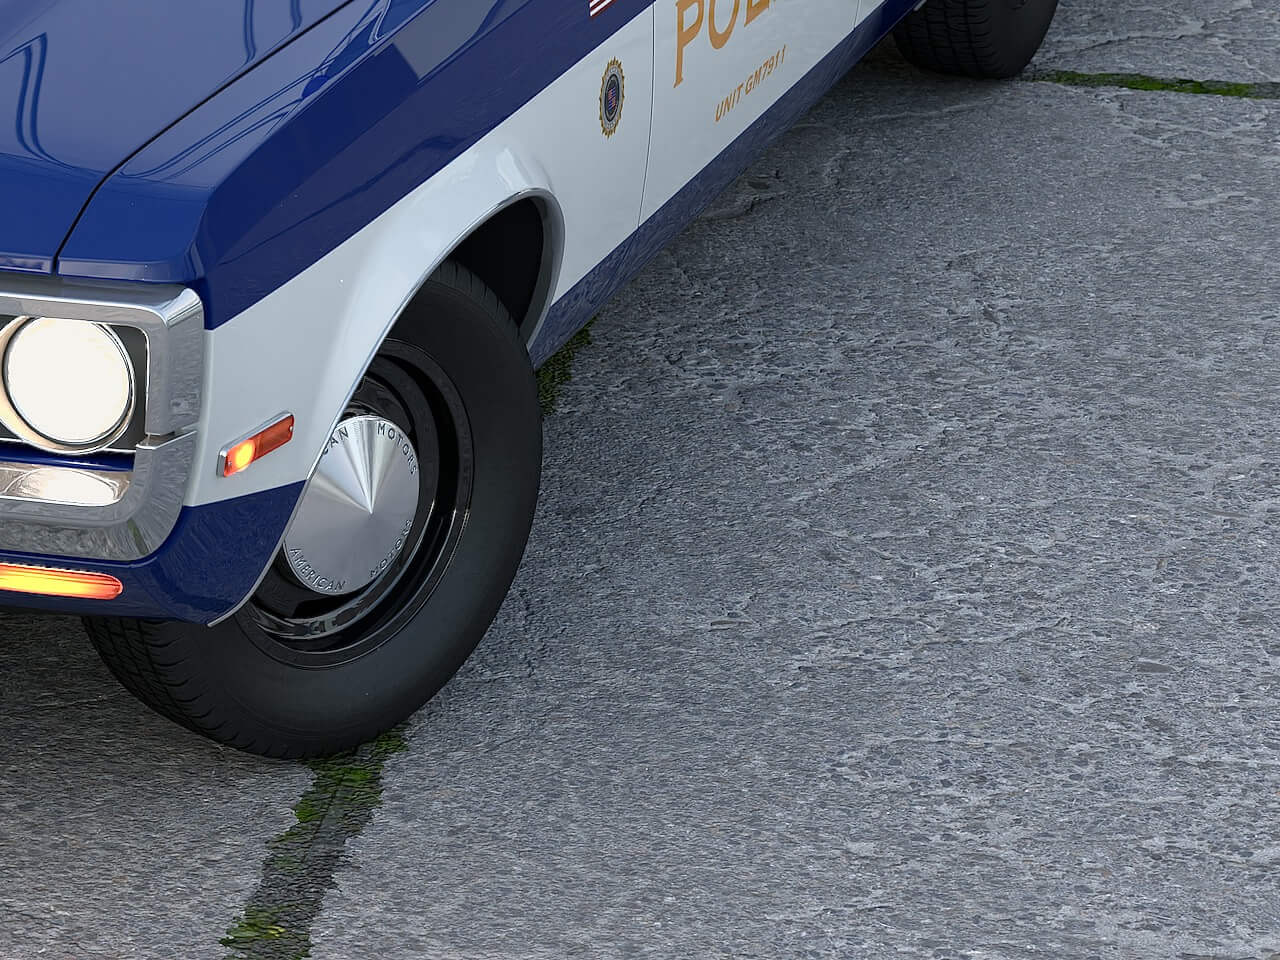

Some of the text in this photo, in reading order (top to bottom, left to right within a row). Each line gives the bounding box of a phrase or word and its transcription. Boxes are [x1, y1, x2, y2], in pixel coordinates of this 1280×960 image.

[715, 43, 787, 122] UNIT GM7911
[376, 421, 418, 476] MOTORS
[289, 547, 346, 592] AMERICAN
